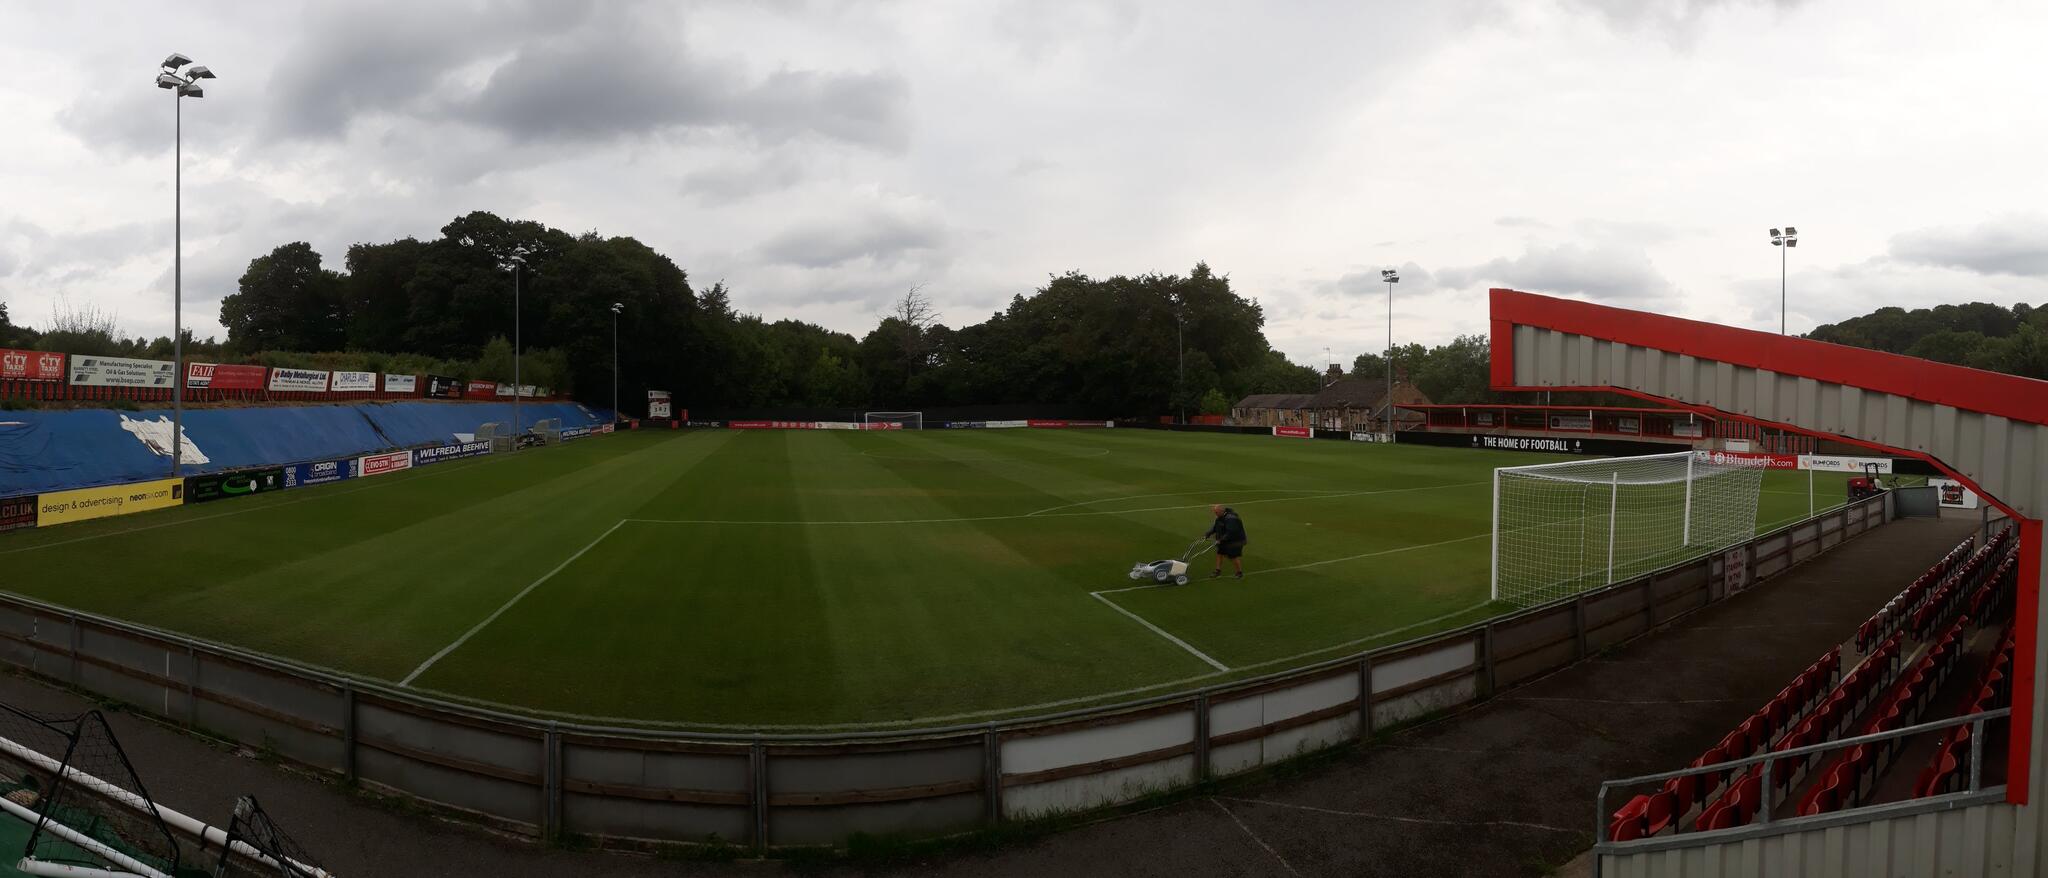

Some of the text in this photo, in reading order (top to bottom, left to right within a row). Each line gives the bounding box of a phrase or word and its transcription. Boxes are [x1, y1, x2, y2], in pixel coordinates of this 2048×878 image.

[3, 351, 27, 365] CITY
[39, 353, 61, 366] CITY
[99, 361, 152, 370] Manufacturing Specialist
[192, 366, 214, 377] FAIR
[420, 445, 461, 458] WILFREDA
[462, 441, 489, 453] BEEHIVE
[1484, 436, 1568, 451] THE HOME OF FOOTBALL
[285, 466, 297, 474] 0800
[314, 461, 337, 472] ORIGIN
[42, 496, 123, 513] design & advertising
